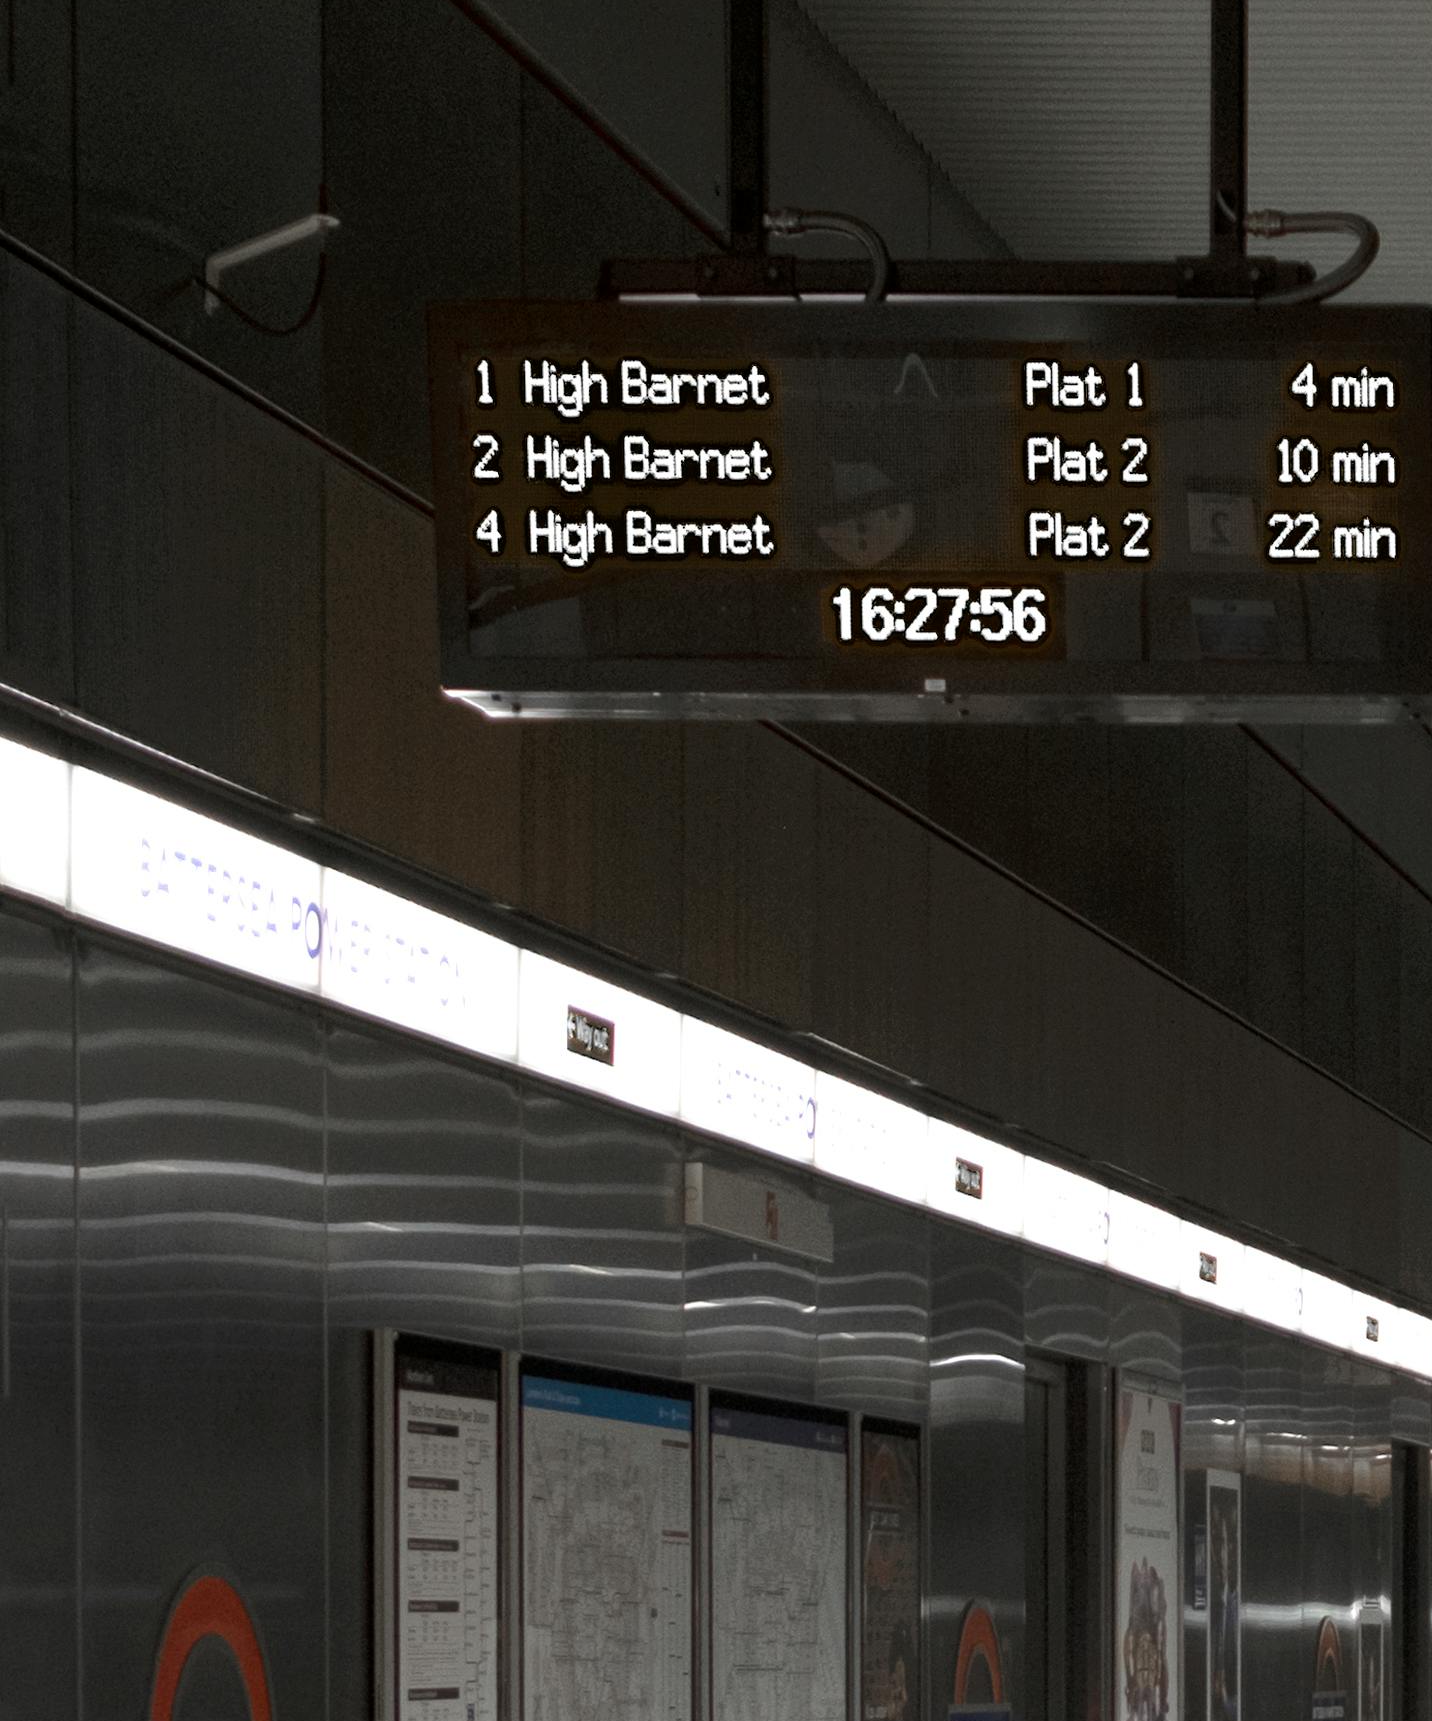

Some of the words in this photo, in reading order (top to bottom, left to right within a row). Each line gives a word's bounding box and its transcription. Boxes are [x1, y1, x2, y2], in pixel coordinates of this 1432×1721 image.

[477, 360, 494, 404] 1
[524, 360, 608, 417] High
[621, 360, 770, 405] Barnet
[1026, 362, 1106, 406] Plat
[1128, 362, 1143, 407] 1
[1291, 363, 1317, 407] 4
[1331, 367, 1394, 408] min
[473, 435, 500, 478] 2
[527, 435, 611, 492] High
[624, 435, 772, 480] Barnet
[1027, 437, 1108, 482] Plat
[1122, 438, 1148, 482] 2
[1278, 438, 1319, 483] 10
[1333, 443, 1395, 483] min
[476, 510, 502, 552] 4
[529, 510, 613, 567] High
[626, 510, 774, 555] Barnet
[1029, 512, 1110, 557] Plat
[1123, 513, 1149, 557] 2
[1269, 513, 1320, 558] 22
[1334, 518, 1396, 558] min
[833, 587, 1046, 642] 16:27:56
